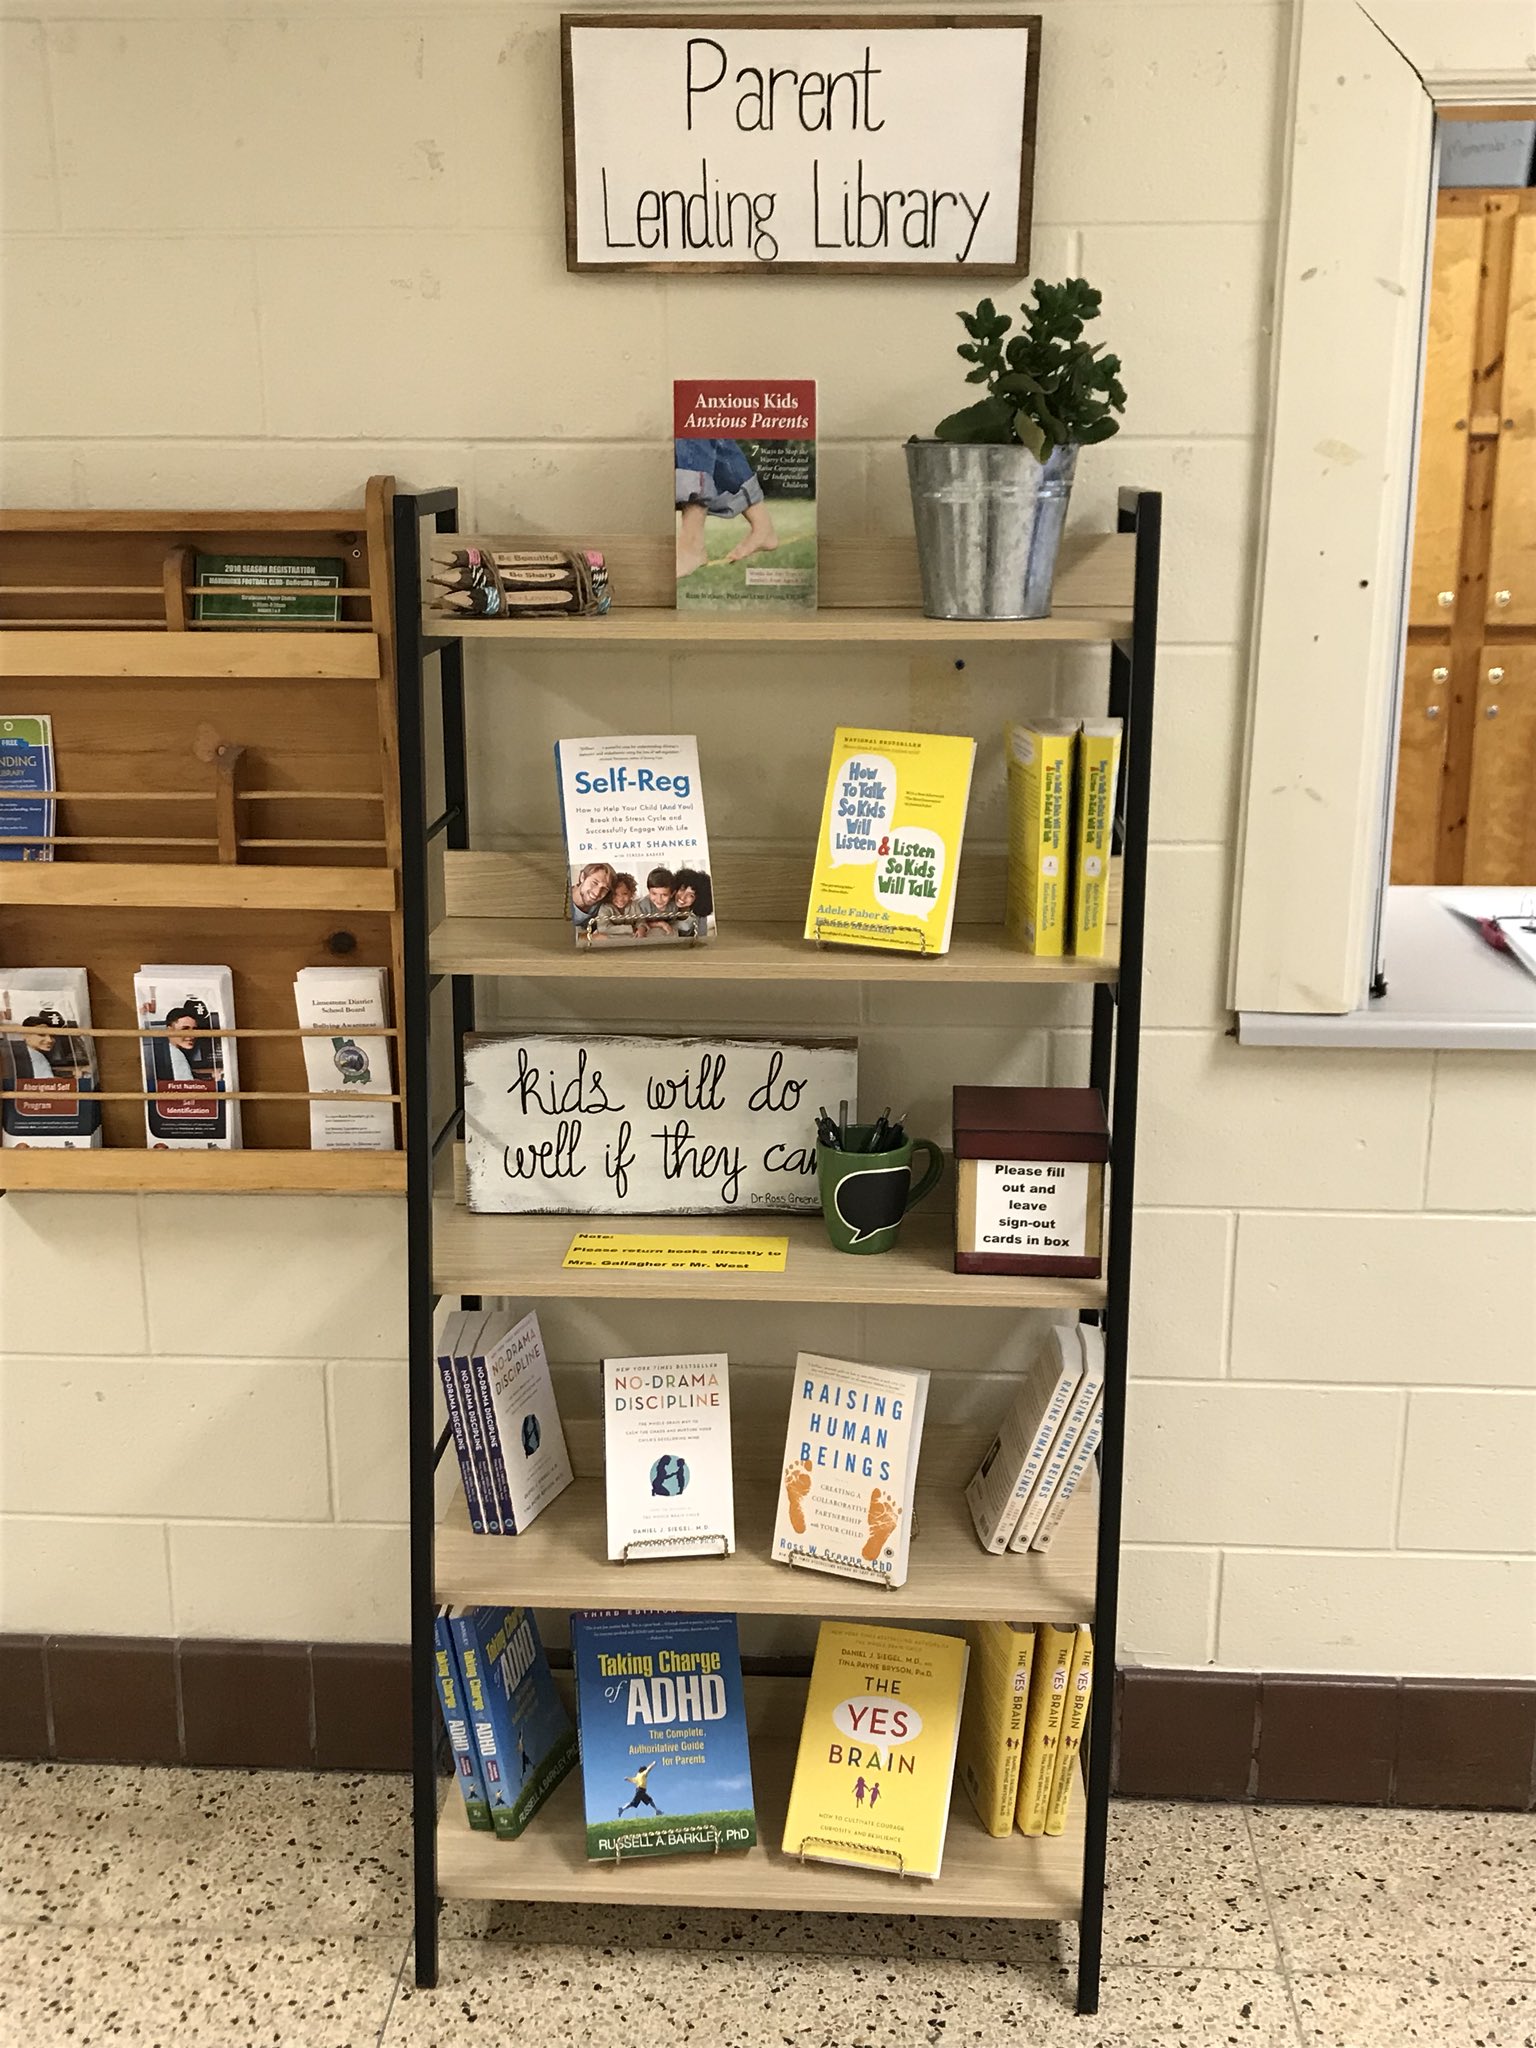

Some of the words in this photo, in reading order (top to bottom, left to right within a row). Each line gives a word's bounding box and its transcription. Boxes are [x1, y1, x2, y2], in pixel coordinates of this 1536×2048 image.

[687, 38, 885, 131] Parent
[602, 157, 778, 261] Lending
[814, 159, 989, 262] Library
[695, 393, 759, 409] Anxious
[764, 393, 798, 409] Kids
[684, 413, 747, 428] Anxious
[751, 413, 809, 428] Parents
[751, 445, 759, 456] 7
[242, 565, 267, 573] SEASON
[269, 566, 316, 574] REGISTRATION
[849, 762, 878, 781] How
[575, 767, 690, 798] Self-Reg
[842, 783, 857, 797] To
[859, 782, 887, 800] Talk
[838, 798, 856, 817] So
[857, 800, 886, 819] Kids
[630, 826, 655, 834] Engage
[847, 819, 872, 835] Will
[602, 841, 641, 849] STUART
[647, 839, 697, 848] SHANKER
[836, 833, 876, 850] Listen
[878, 836, 890, 856] &
[893, 838, 935, 858] Listen
[886, 858, 902, 874] So
[904, 859, 935, 878] Kids
[878, 876, 905, 895] Will
[908, 879, 937, 898] Talk
[817, 904, 847, 916] Adele
[848, 908, 880, 919] Faber
[881, 912, 890, 921] &
[23, 1083, 56, 1092] Aboriginal
[507, 1048, 626, 1115] kids
[646, 1053, 726, 1112] will
[748, 1050, 808, 1112] do
[23, 1102, 51, 1110] Program
[504, 1119, 587, 1179] well
[605, 1121, 636, 1198] if
[651, 1120, 748, 1204] they
[995, 1165, 1042, 1176] Please
[1047, 1167, 1064, 1177] fill
[1002, 1184, 1025, 1193] out
[1030, 1185, 1055, 1194] and
[1009, 1200, 1047, 1211] leave
[999, 1217, 1056, 1229] sign-out
[983, 1234, 1022, 1244] cards
[1027, 1235, 1039, 1245] in
[1044, 1236, 1069, 1247] box
[601, 1260, 668, 1268] Gallagher
[496, 1344, 541, 1395] DISCIPLINE
[615, 1374, 718, 1390] NO-DRAMA
[616, 1393, 719, 1411] DISCIPLINE
[803, 1380, 903, 1420] RAISING
[1048, 1380, 1072, 1422] RAISING
[1072, 1382, 1097, 1422] RAISING
[810, 1413, 887, 1449] HUMAN
[1032, 1425, 1053, 1459] HUMAN
[1056, 1426, 1077, 1459] HUMAN
[1078, 1428, 1100, 1462] HUMAN
[800, 1442, 890, 1481] BEINGS
[1016, 1462, 1037, 1498] BEINGS
[1039, 1462, 1061, 1498] BEINGS
[1061, 1464, 1083, 1500] BEINGS
[820, 1484, 856, 1497] CREATING
[812, 1495, 867, 1513] COLLABORATIVE
[815, 1509, 862, 1525] PARTNERSHIP
[436, 1650, 449, 1677] Taking
[501, 1619, 536, 1701] ADHD
[597, 1653, 652, 1678] Taking
[659, 1651, 720, 1674] Charge
[1018, 1650, 1027, 1666] THE
[1058, 1649, 1067, 1665] THE
[1082, 1651, 1091, 1666] THE
[865, 1677, 902, 1695] THE
[1015, 1672, 1025, 1691] YES
[1054, 1671, 1065, 1689] YES
[1077, 1672, 1089, 1691] YES
[442, 1679, 456, 1709] Charge
[605, 1680, 627, 1703] of
[626, 1674, 727, 1725] ADHD
[1011, 1696, 1023, 1730] BRAIN
[1048, 1694, 1061, 1728] BRAIN
[1071, 1695, 1085, 1729] BRAIN
[848, 1704, 908, 1738] YES
[448, 1720, 470, 1752] ADHD
[649, 1730, 663, 1739] The
[629, 1744, 678, 1755] Authoritative
[681, 1742, 704, 1751] Guide
[662, 1757, 673, 1766] for
[675, 1755, 705, 1765] Parents
[829, 1744, 915, 1775] BRAIN
[844, 1817, 874, 1826] CULTIVATE
[599, 1835, 653, 1850] RUSSELL
[656, 1834, 666, 1846] A.
[668, 1830, 723, 1845] BARKLEY,
[726, 1828, 749, 1840] PhD
